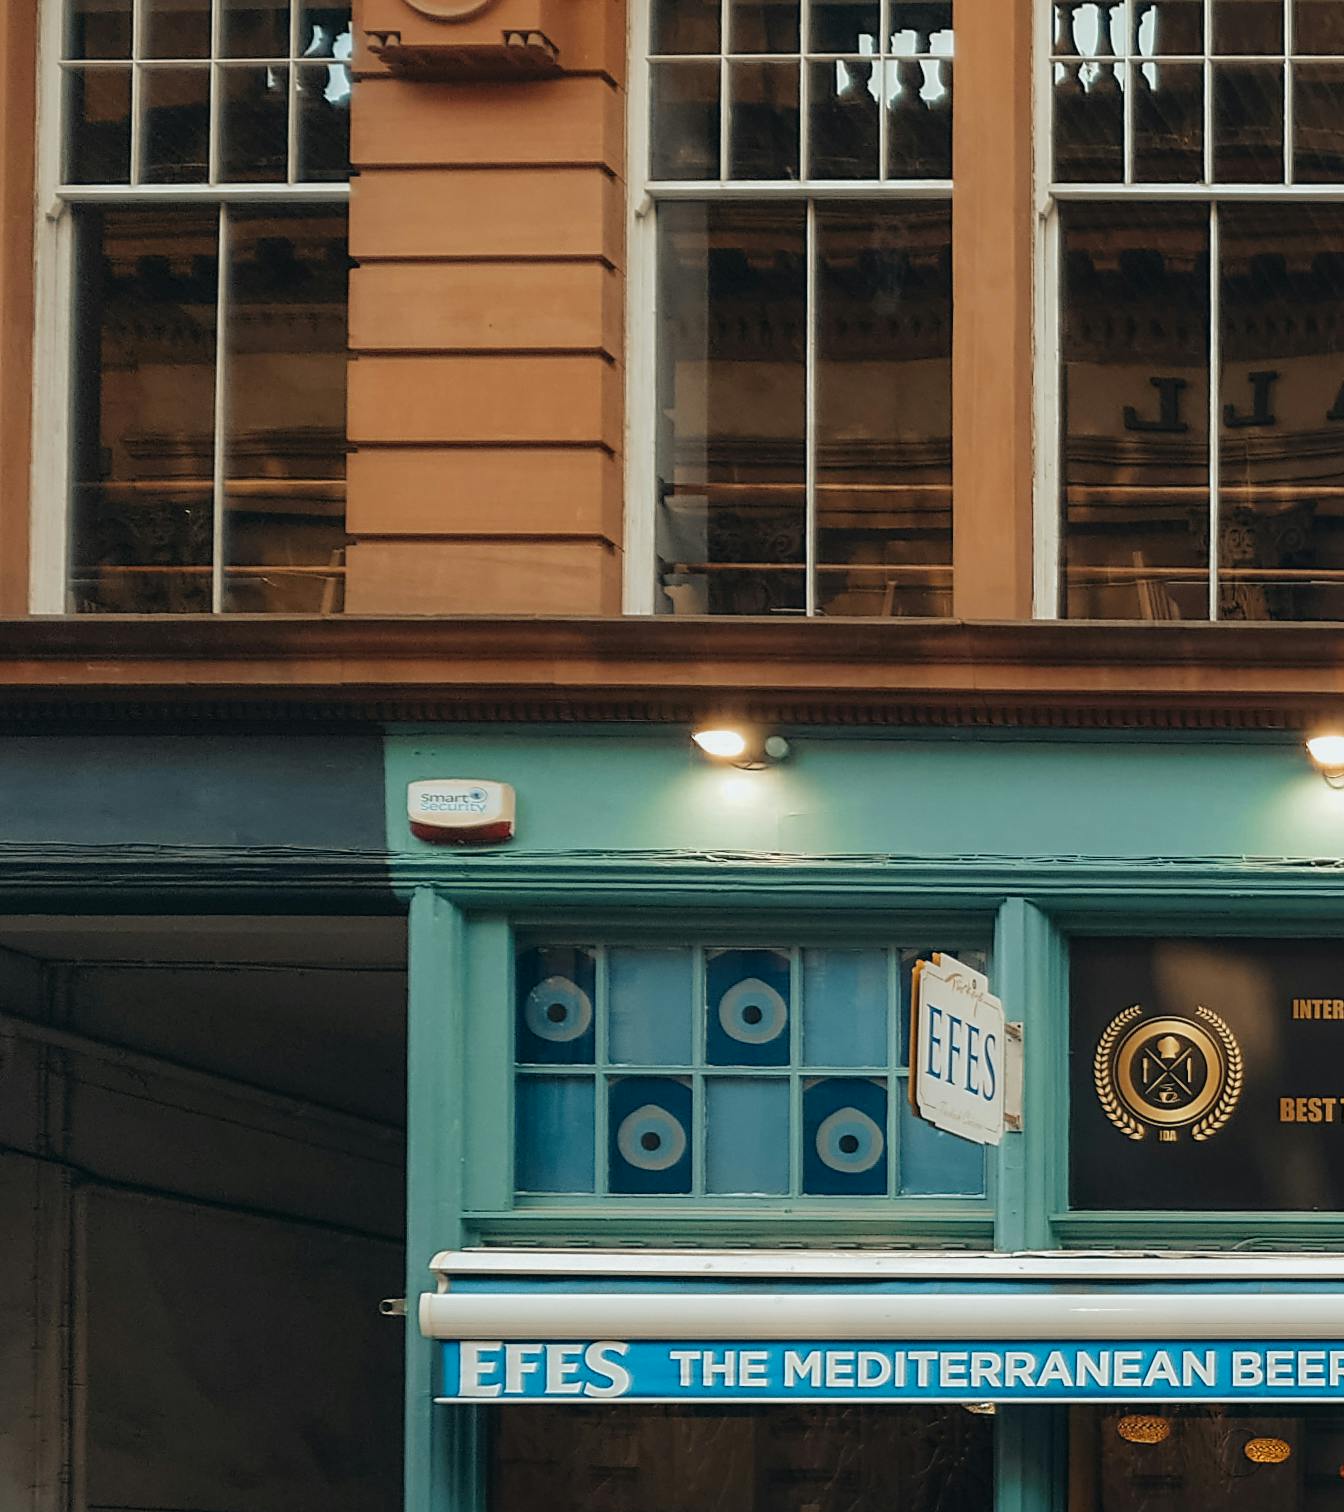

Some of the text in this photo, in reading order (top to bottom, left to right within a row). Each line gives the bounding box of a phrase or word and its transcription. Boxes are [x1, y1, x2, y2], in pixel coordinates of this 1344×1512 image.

[925, 1003, 996, 1101] EFES
[1279, 1097, 1337, 1123] BEST
[457, 1340, 631, 1398] EFES
[669, 1350, 769, 1388] THE
[783, 1350, 1217, 1388] MEDITERRANEAN
